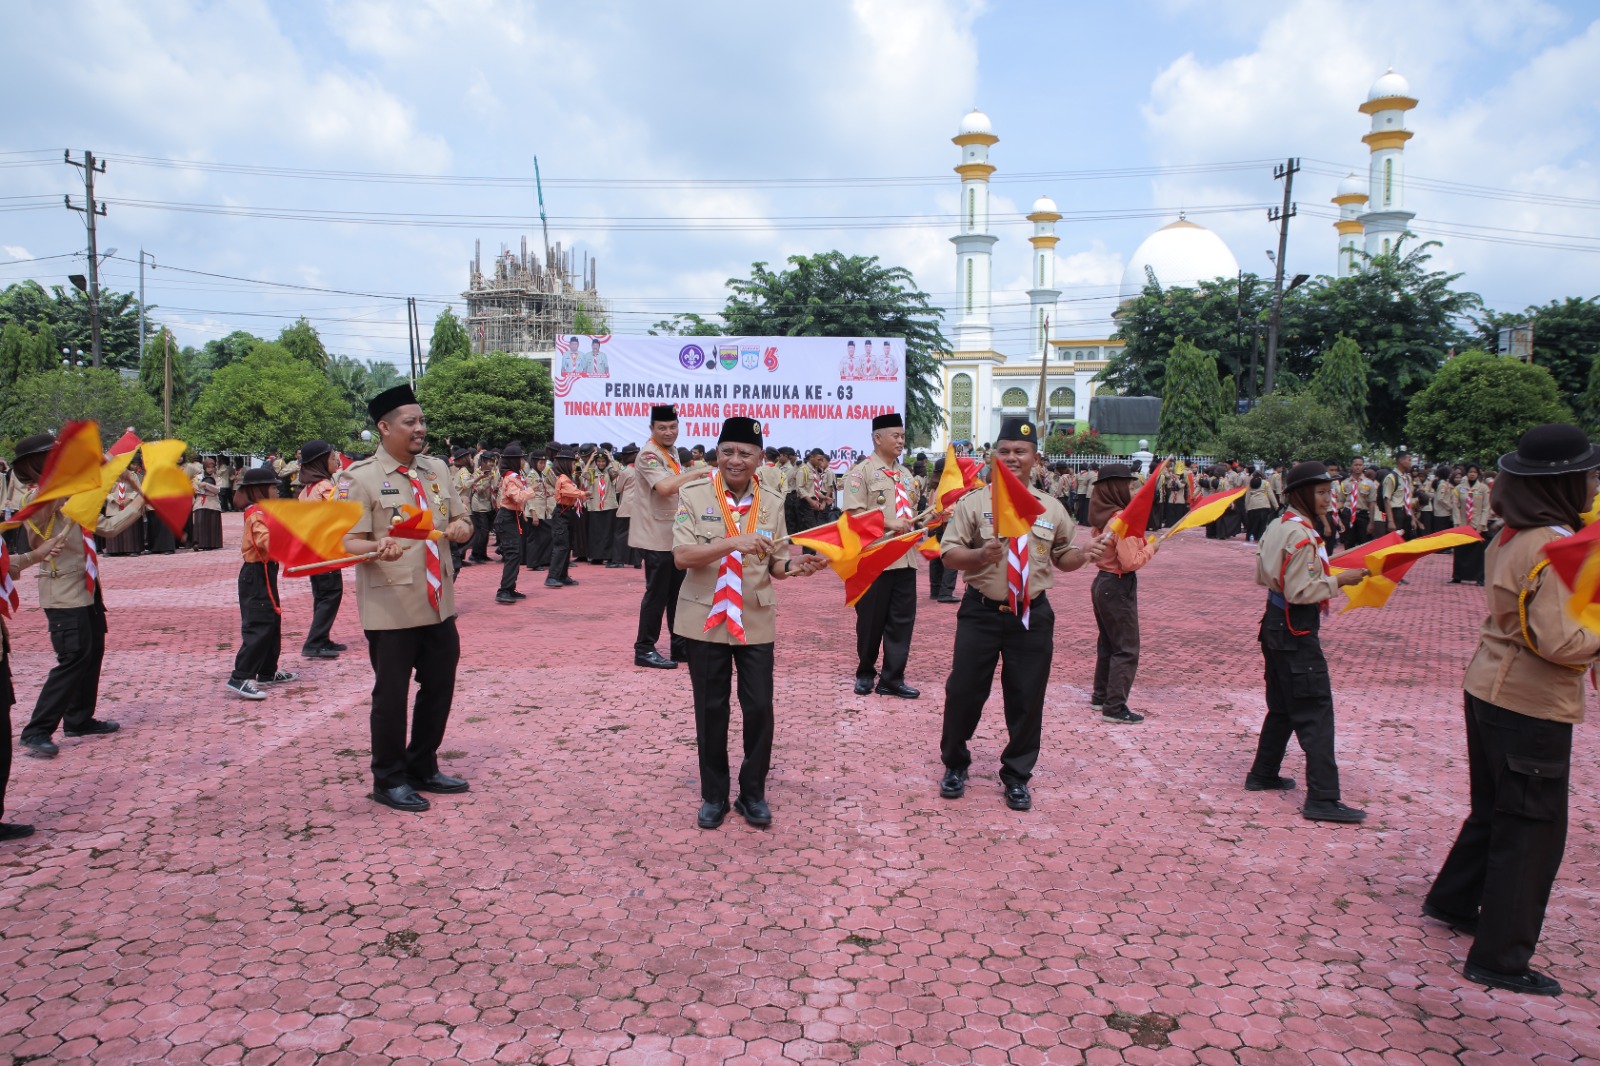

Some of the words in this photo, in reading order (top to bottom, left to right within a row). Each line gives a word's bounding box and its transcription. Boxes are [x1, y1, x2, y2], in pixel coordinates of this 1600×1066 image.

[605, 382, 690, 398] PERINGATAN
[694, 383, 728, 399] HARI
[733, 384, 800, 400] PRAMUKA
[805, 385, 823, 400] KE
[836, 385, 853, 400] 63
[564, 401, 612, 416] TINGKAT
[615, 402, 667, 417] KWAR
[722, 403, 780, 419] GERAKAN
[783, 404, 843, 419] PRAMUKA
[846, 404, 895, 419] ASAHAN
[685, 422, 725, 437] TAHU
